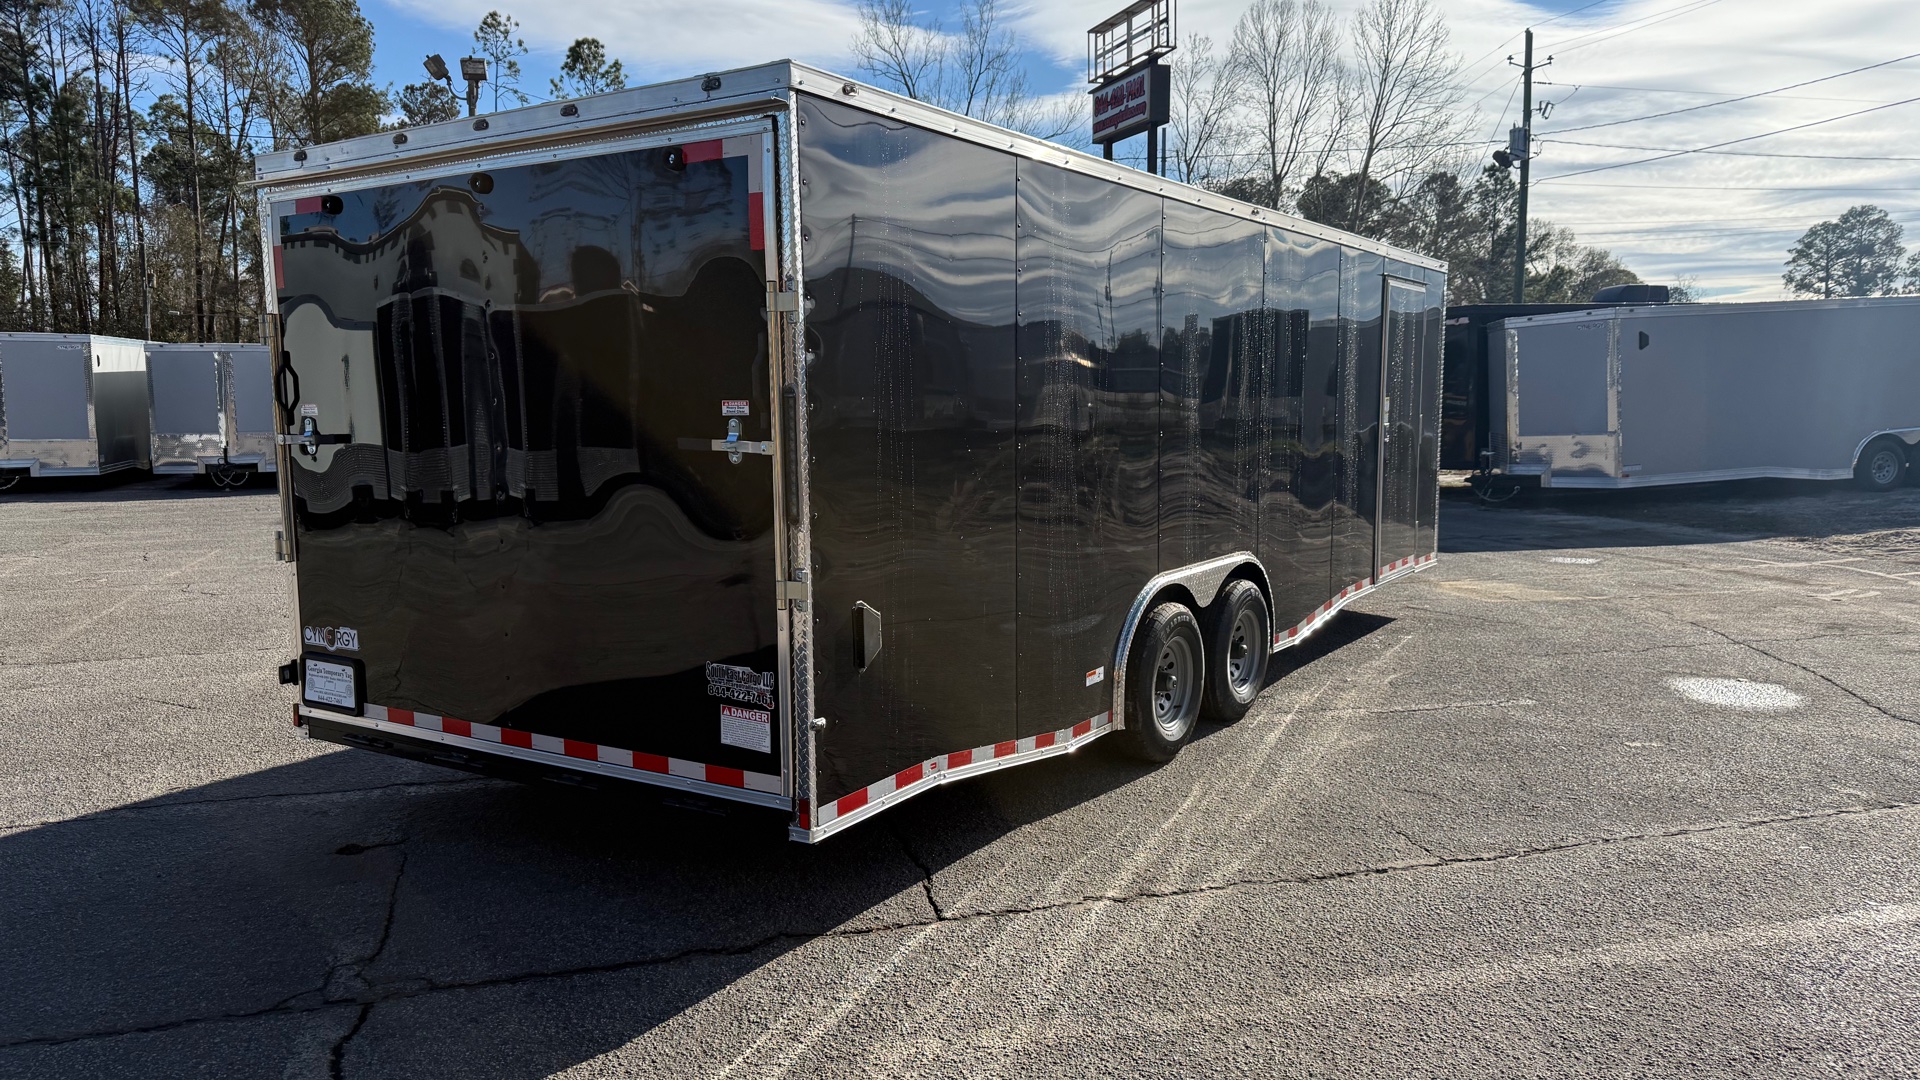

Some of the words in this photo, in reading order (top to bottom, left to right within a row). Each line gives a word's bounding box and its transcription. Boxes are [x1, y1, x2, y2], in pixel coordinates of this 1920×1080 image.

[304, 626, 356, 648] CYNERGY
[307, 665, 323, 674] Georgia
[322, 667, 345, 678] Temporary
[345, 671, 353, 680] Tag
[706, 661, 726, 680] South
[741, 670, 762, 686] Cargo
[762, 671, 774, 690] LLC
[708, 684, 774, 705] 844-422-7461
[731, 707, 768, 722] DANGER
